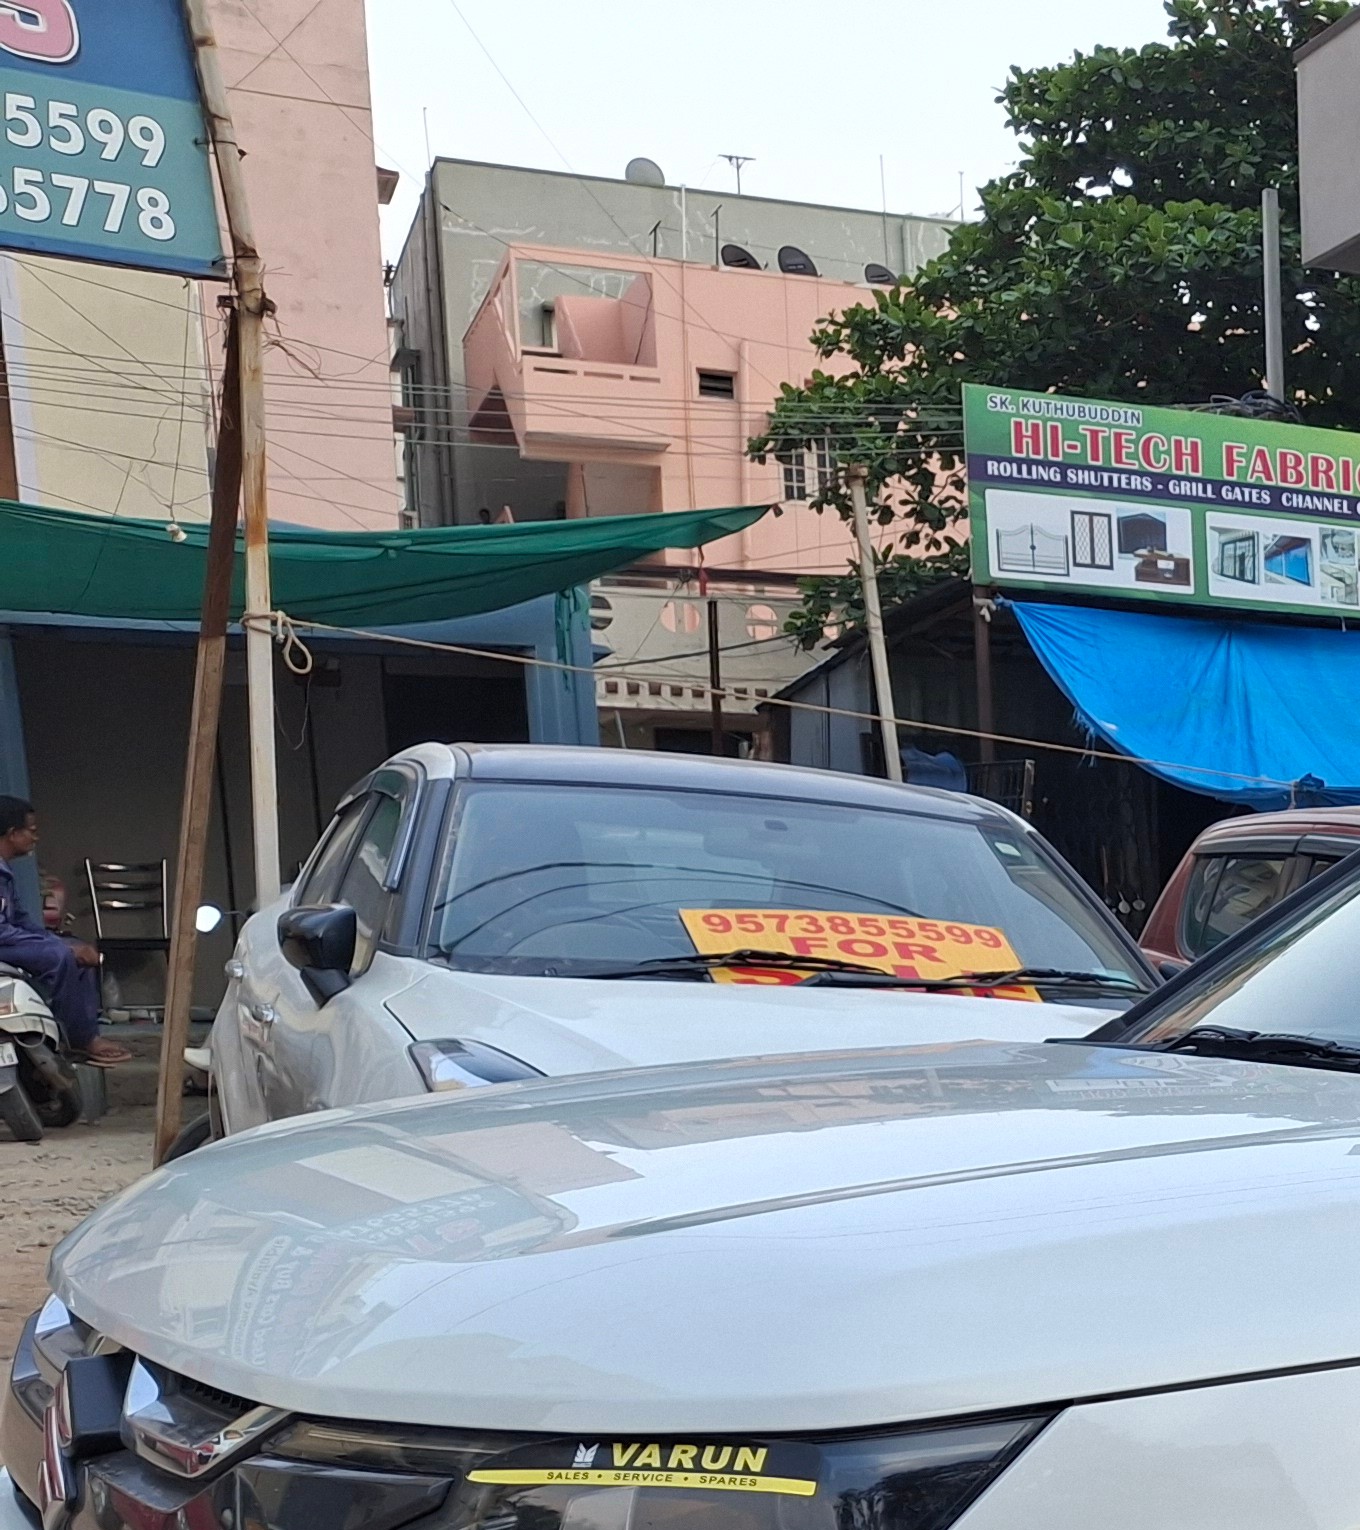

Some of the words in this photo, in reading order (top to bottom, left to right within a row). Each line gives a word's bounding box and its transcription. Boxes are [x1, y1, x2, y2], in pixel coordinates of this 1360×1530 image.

[4, 91, 167, 168] 5599
[0, 166, 176, 241] 5778
[987, 394, 1015, 413] SK.
[1020, 397, 1142, 427] KUTHUBUDDIN
[1011, 418, 1203, 476] HI-TECH
[987, 460, 1061, 482] ROLLING
[1066, 468, 1152, 492] SHUTTERS
[1168, 478, 1216, 499] GRILL
[1221, 487, 1271, 505] GATES
[1281, 491, 1352, 515] CHANNEL
[701, 912, 1003, 949] 9573855599
[788, 935, 947, 964] FOR
[611, 1441, 769, 1473] VARUN
[546, 1470, 590, 1481] SALES
[613, 1472, 674, 1483] SERVICE
[699, 1475, 758, 1487] SPARES
